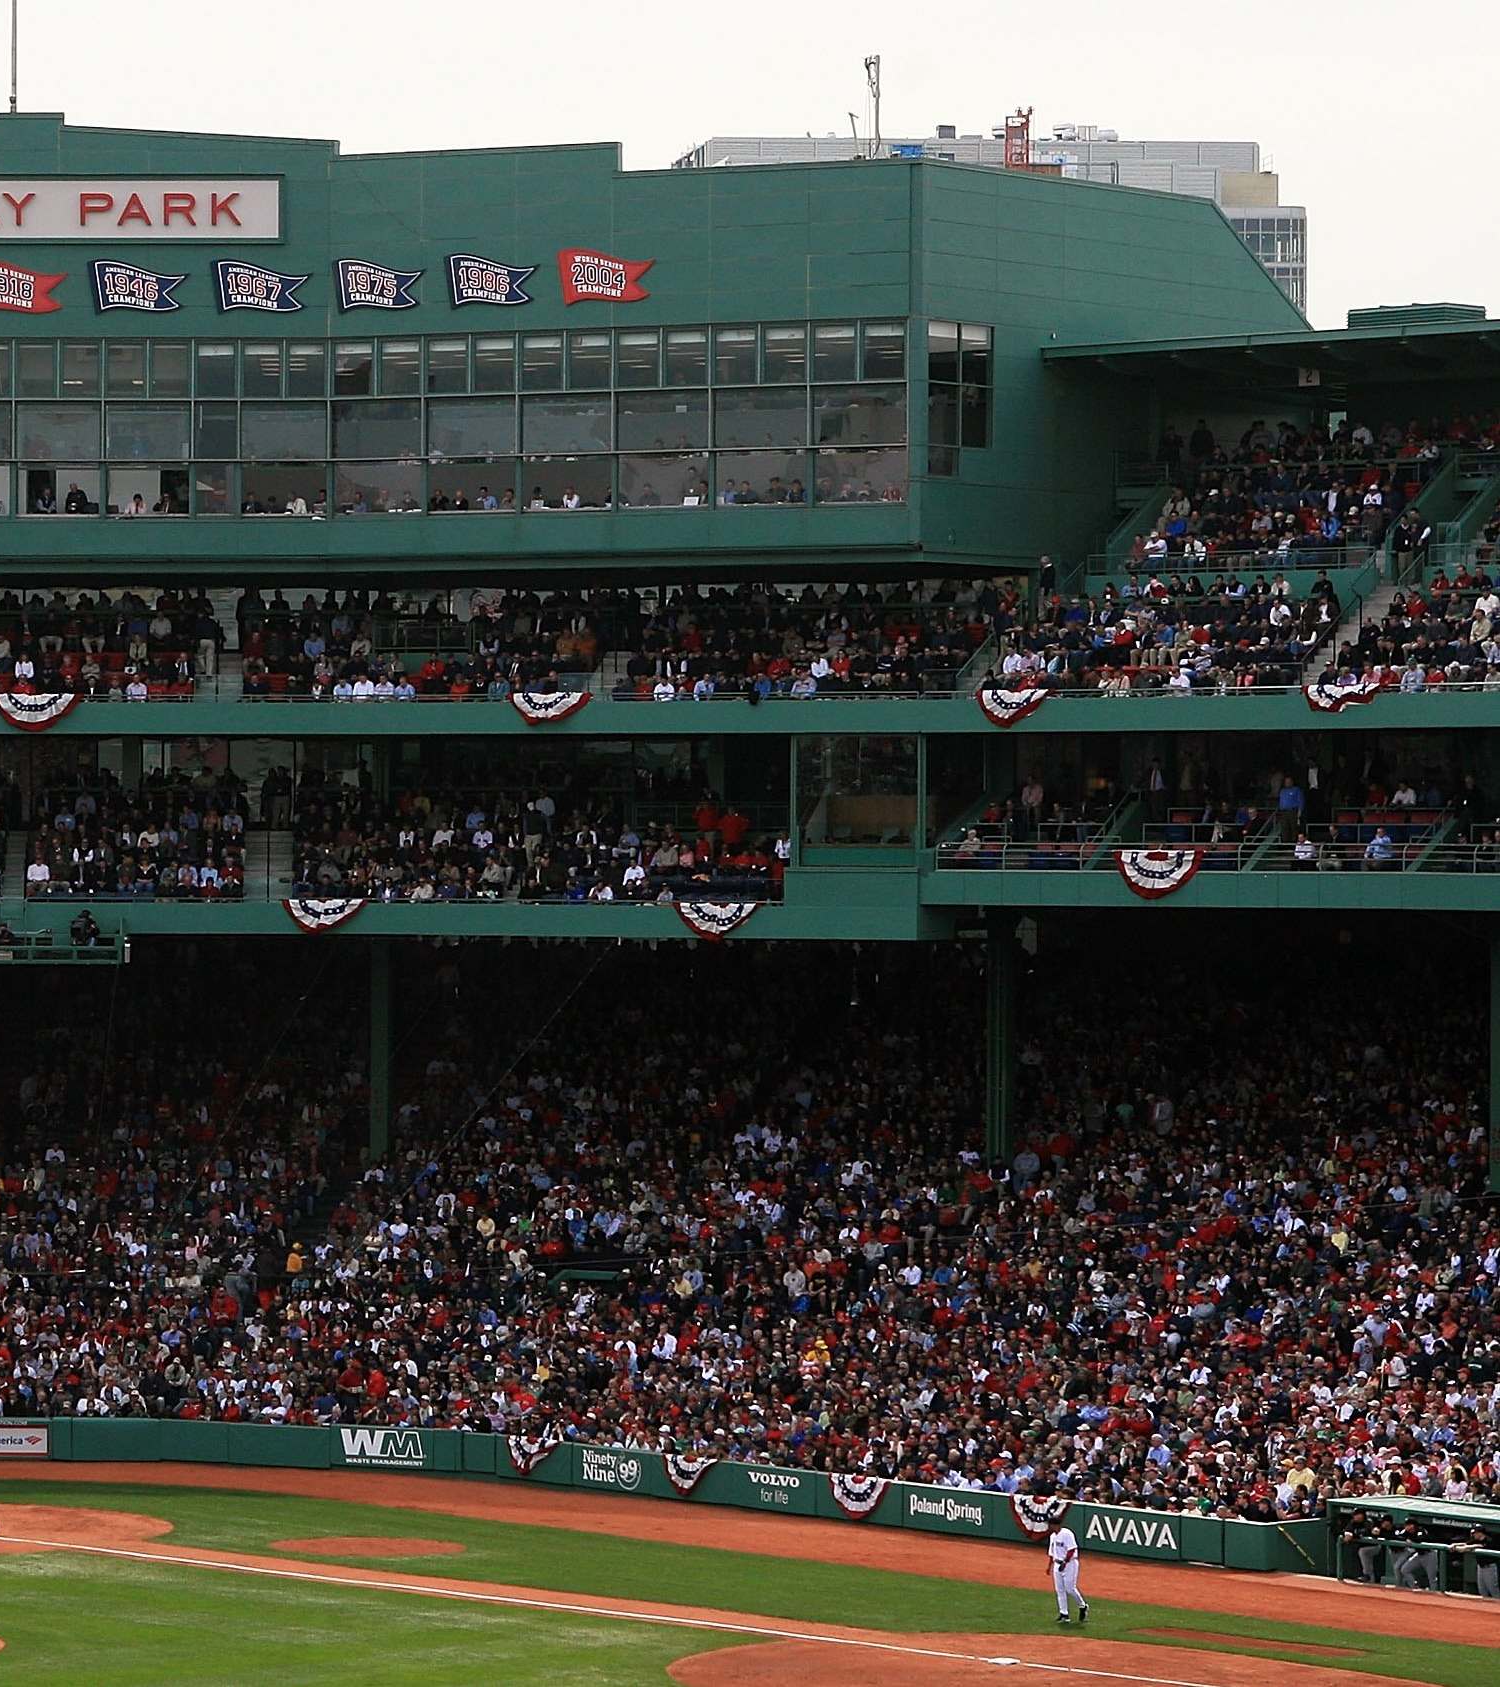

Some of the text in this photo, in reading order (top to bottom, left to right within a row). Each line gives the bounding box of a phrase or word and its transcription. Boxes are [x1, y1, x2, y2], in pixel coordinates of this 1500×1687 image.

[79, 191, 242, 227] PARK
[461, 261, 508, 275] AMERICAN LEAGUE
[574, 256, 623, 270] WORLD SERIES
[10, 270, 34, 281] SERIES
[105, 267, 156, 281] AMERICAN LEAGUE
[228, 267, 280, 282] AMERICAN LEAGUE
[348, 265, 395, 279] AMERICAN LEAGUE
[459, 267, 510, 294] 1986
[571, 263, 625, 290] 2004
[105, 273, 158, 300] 1946
[227, 273, 281, 300] 1967
[348, 271, 397, 298] 1975
[577, 285, 621, 297] CHAMPIONS
[109, 295, 155, 308] CHAMPIONS
[231, 295, 278, 308] CHAMPIONS
[351, 293, 393, 305] CHAMPIONS
[463, 289, 506, 301] CHAMPIONS
[340, 1429, 423, 1458] WM
[583, 1449, 617, 1468] Ninety
[583, 1463, 615, 1482] Nine
[619, 1460, 637, 1478] 99
[748, 1471, 800, 1488] VOLVO
[760, 1488, 789, 1504] for life
[910, 1494, 982, 1526] Poland Spring
[1085, 1514, 1177, 1550] AVAYA
